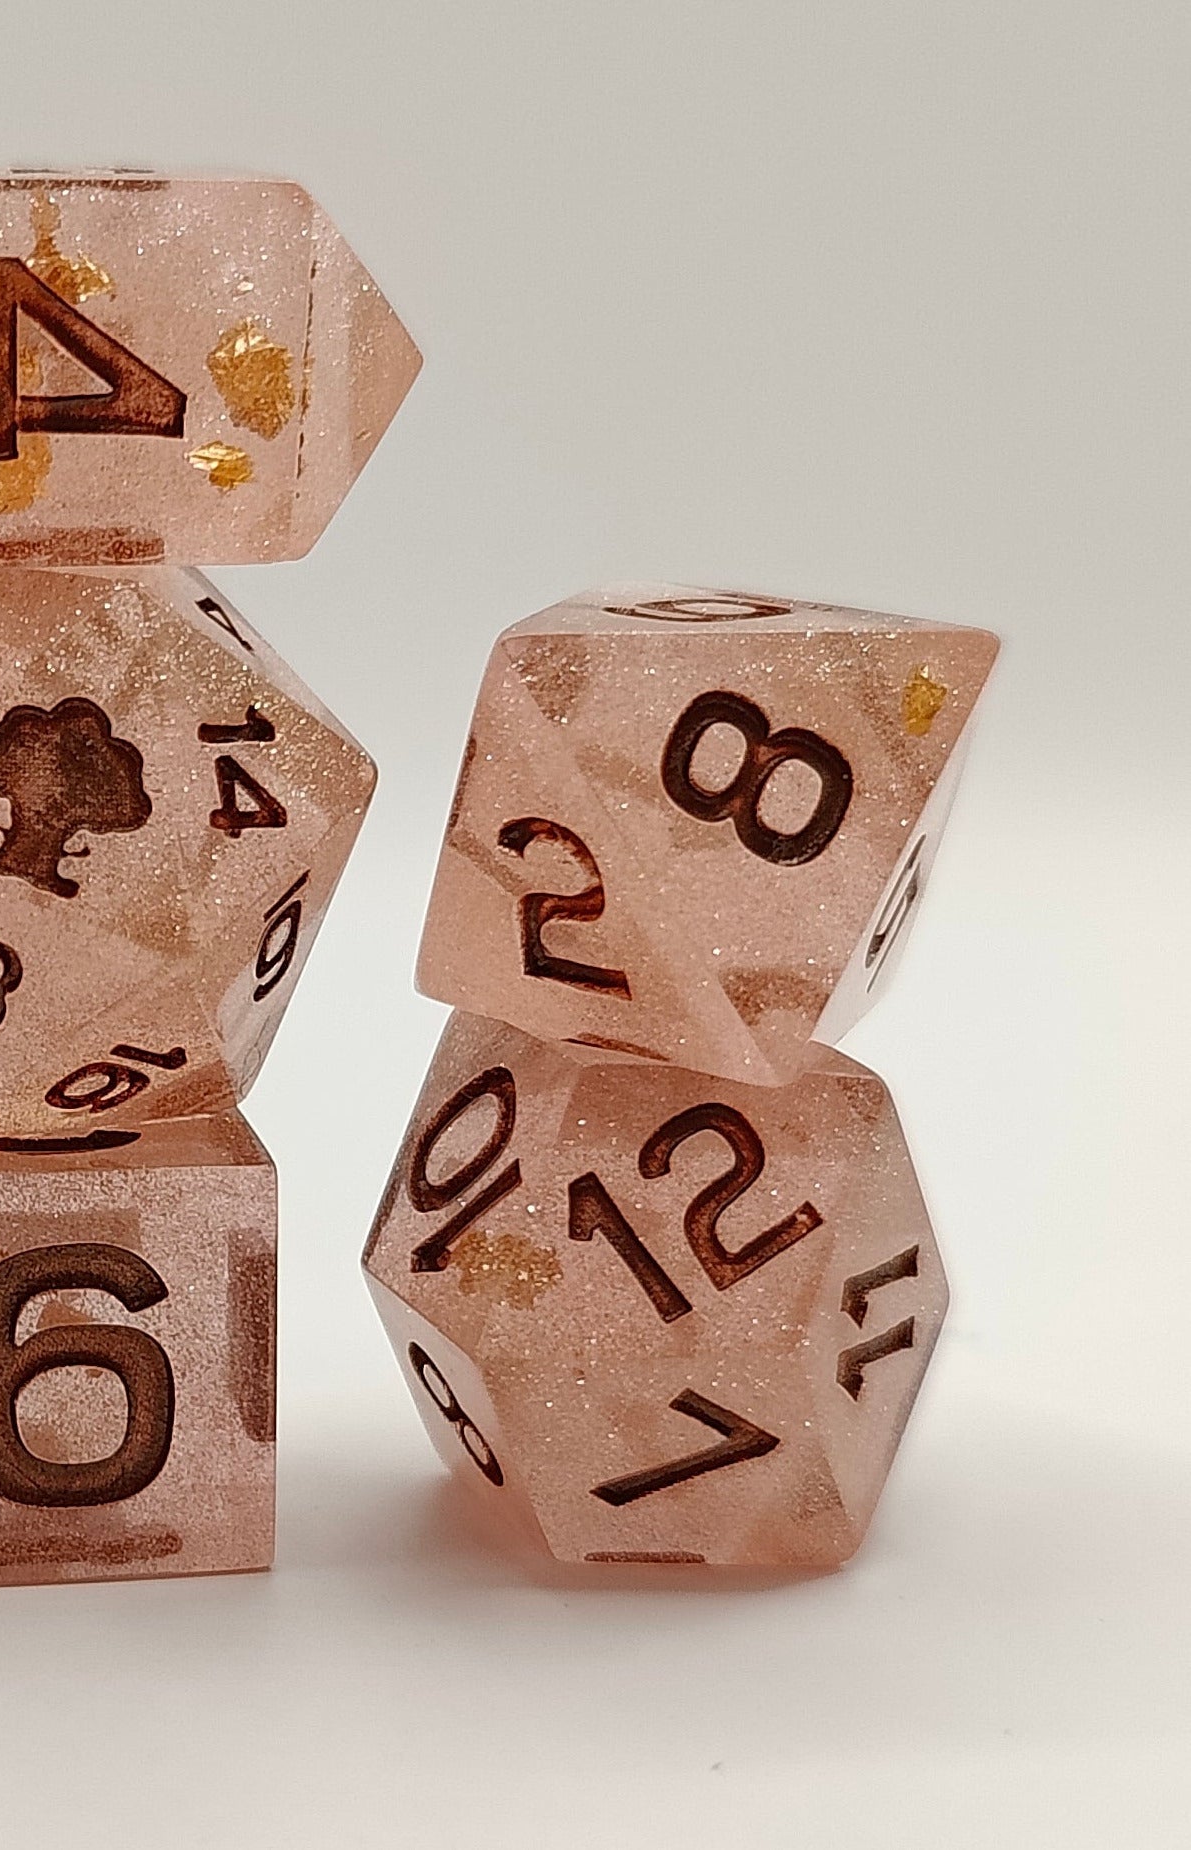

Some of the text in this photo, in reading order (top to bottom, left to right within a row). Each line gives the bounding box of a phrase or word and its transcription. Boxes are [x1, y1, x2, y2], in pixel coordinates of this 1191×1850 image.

[193, 596, 256, 657] 4
[197, 704, 288, 839] 14
[661, 690, 854, 867] 8
[496, 816, 633, 1001] 2
[407, 1065, 523, 1273] 10
[567, 1101, 824, 1324] 12
[835, 1243, 920, 1402] 11
[407, 1340, 505, 1488] 8
[589, 1387, 782, 1508] 7
